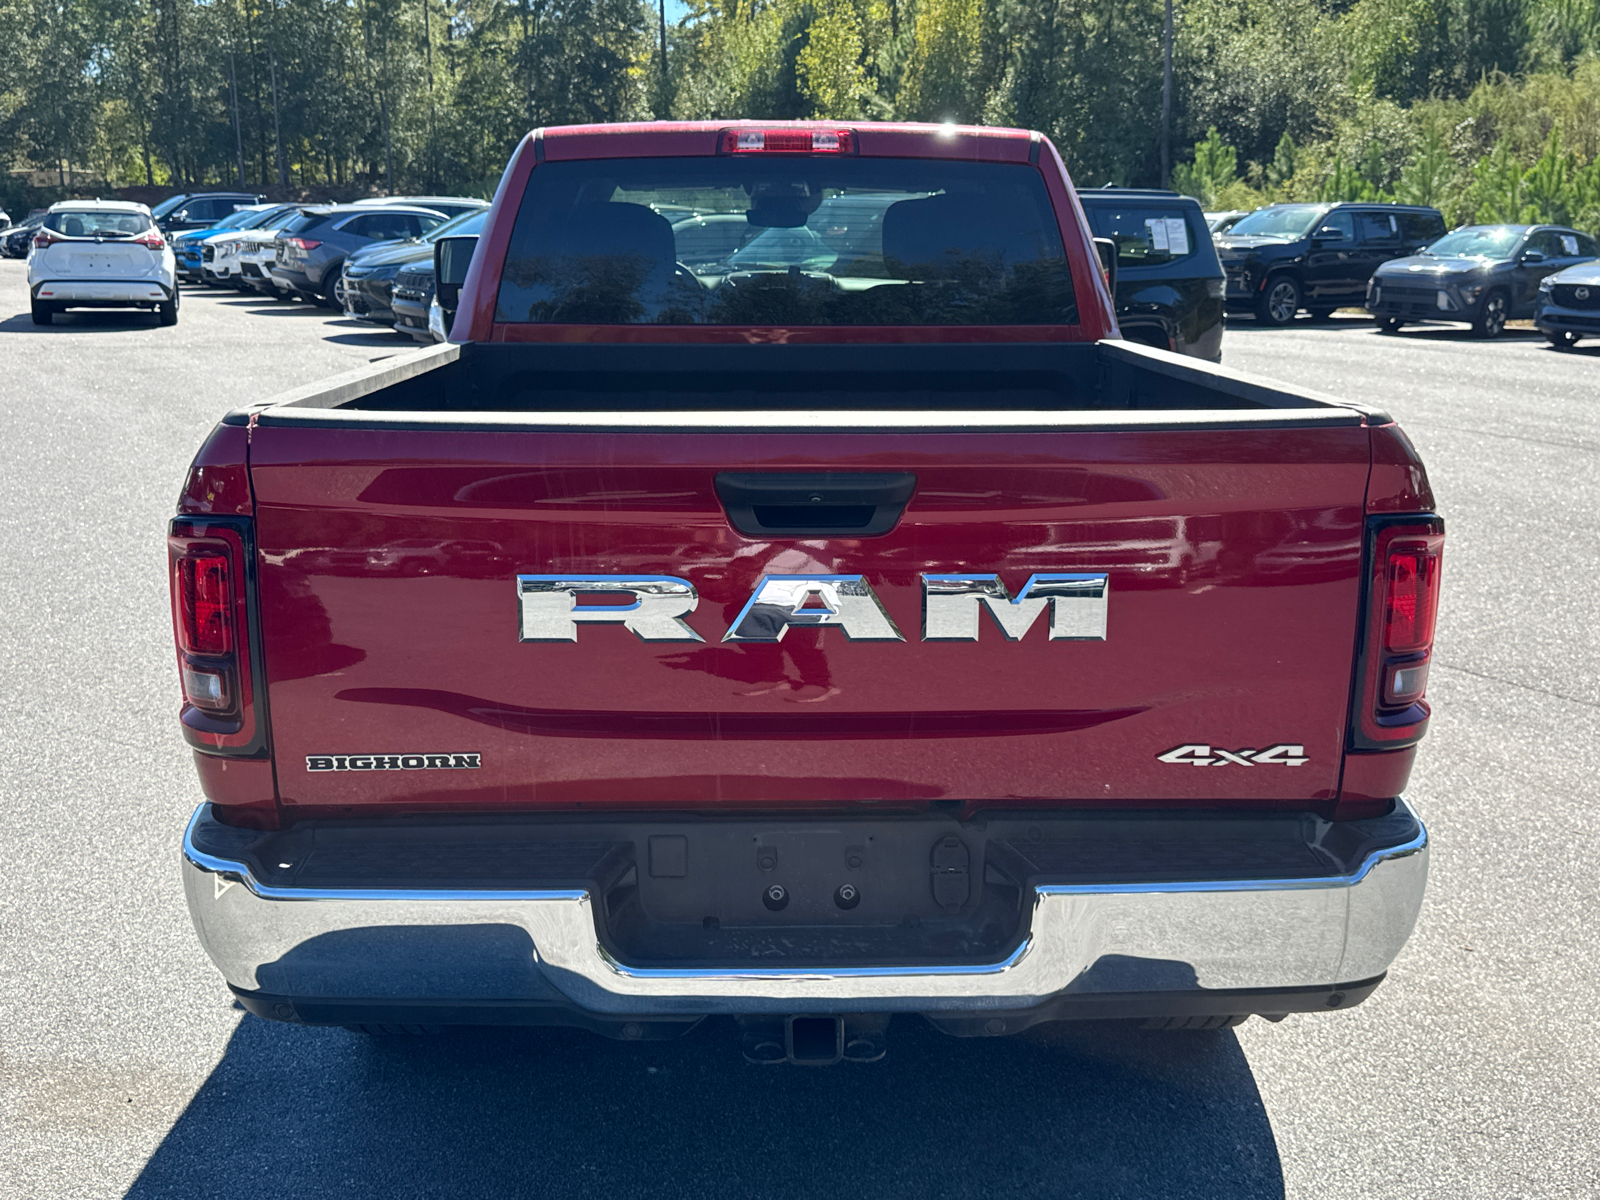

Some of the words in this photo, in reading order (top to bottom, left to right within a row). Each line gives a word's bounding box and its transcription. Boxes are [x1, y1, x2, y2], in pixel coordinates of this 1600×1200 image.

[517, 574, 1109, 642] RAM
[306, 753, 481, 771] BIGHORN
[1156, 744, 1310, 767] 4x4
